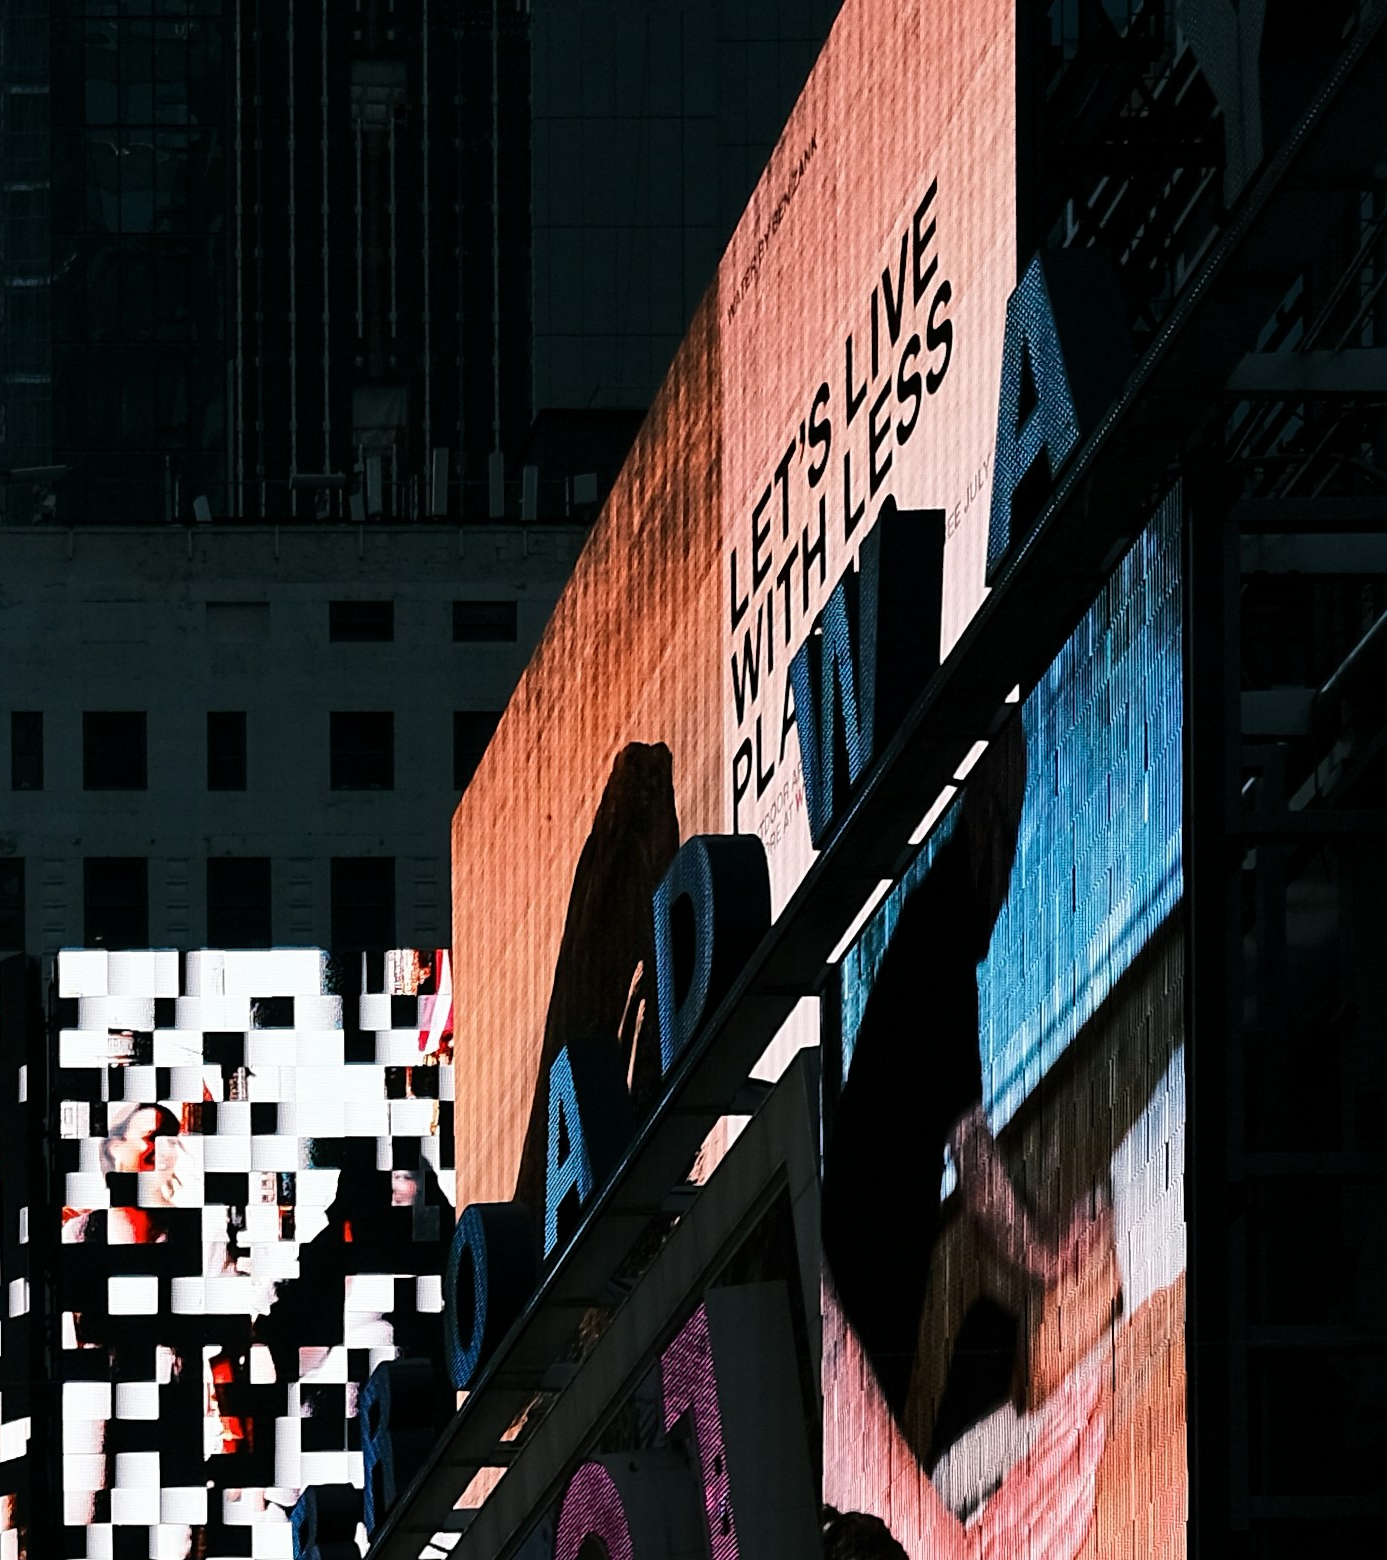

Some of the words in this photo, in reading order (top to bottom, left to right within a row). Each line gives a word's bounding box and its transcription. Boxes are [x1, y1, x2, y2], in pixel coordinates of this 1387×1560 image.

[731, 382, 831, 636] LET'S
[846, 176, 938, 428] LIVE
[732, 492, 827, 729] WITH
[844, 280, 953, 546] LESS
[733, 670, 796, 834] PLA
